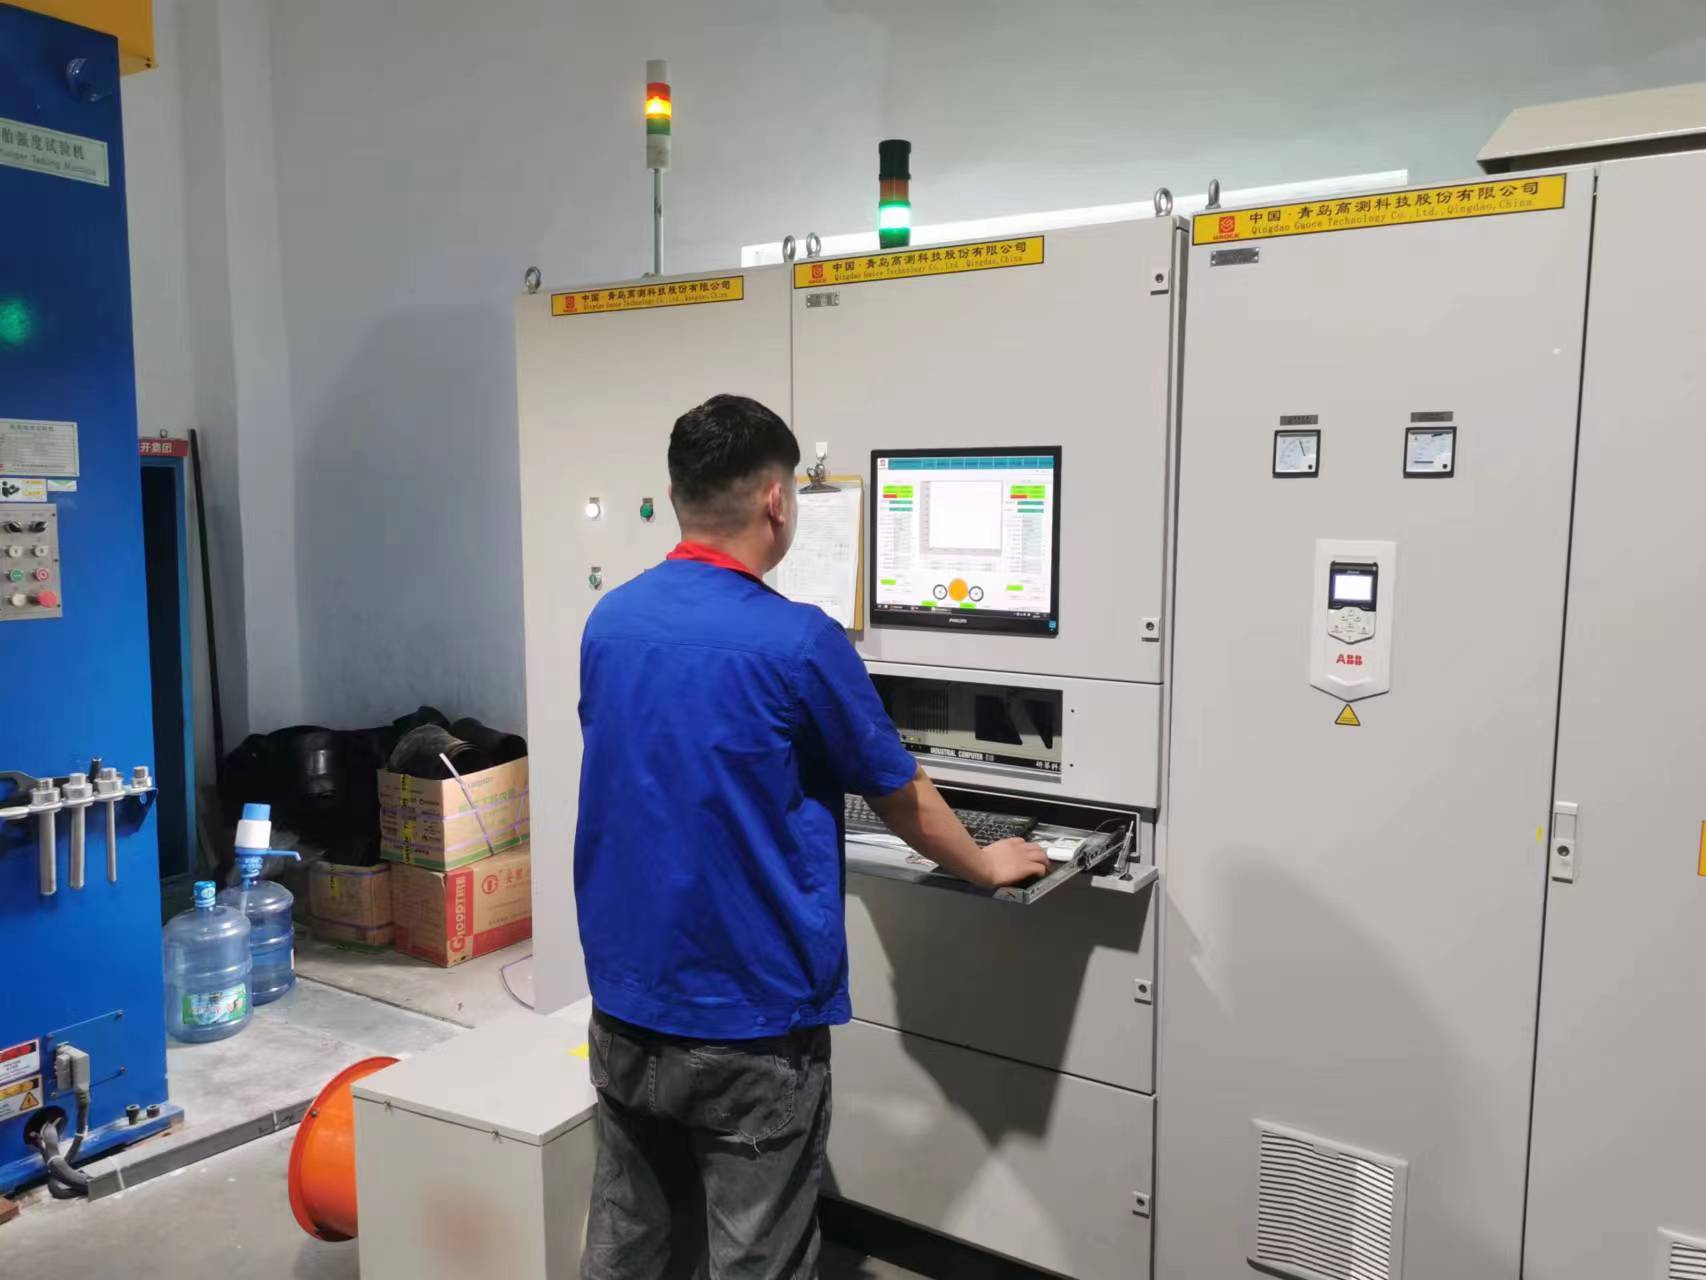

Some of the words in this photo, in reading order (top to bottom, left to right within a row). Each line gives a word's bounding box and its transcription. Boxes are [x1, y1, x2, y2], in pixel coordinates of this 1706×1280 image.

[1251, 224, 1290, 235] Qingdao
[1294, 219, 1323, 231] Gaoce
[1328, 213, 1386, 227] Technology
[1336, 653, 1363, 666] ABB
[958, 749, 985, 761] COMPUTER
